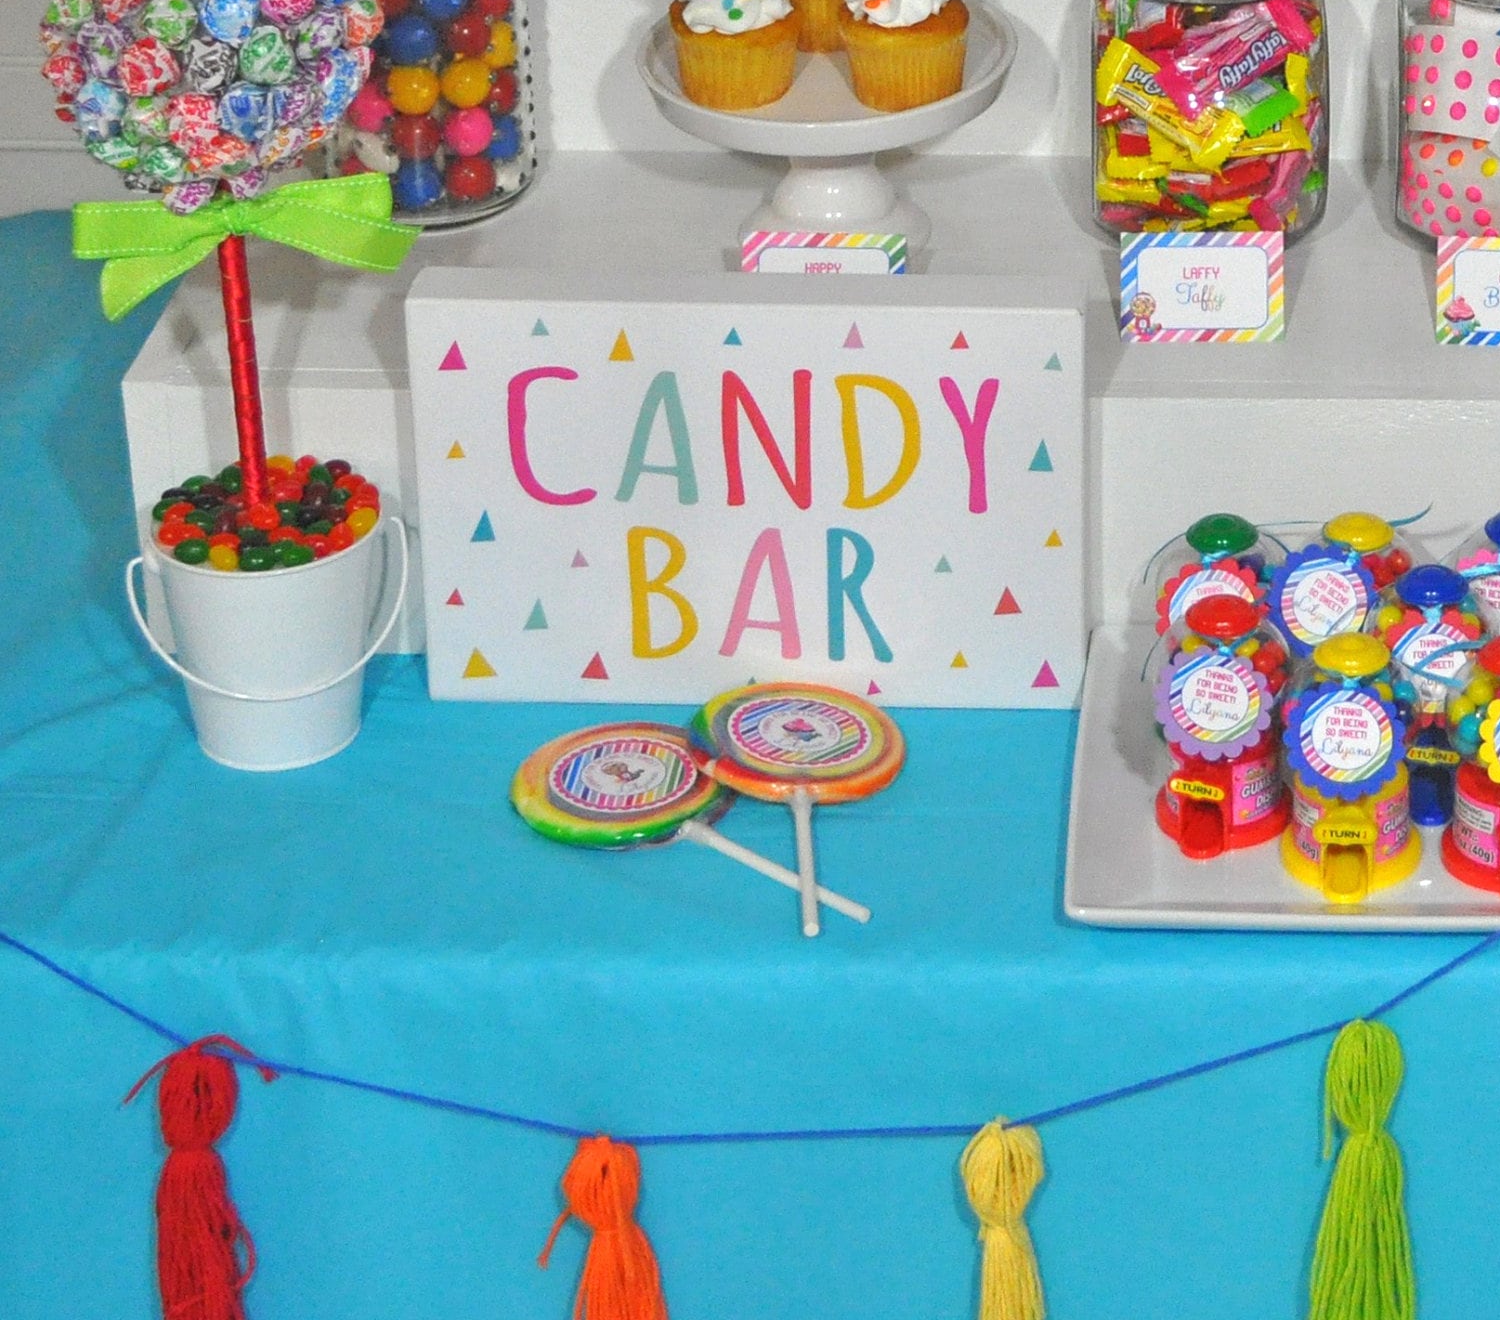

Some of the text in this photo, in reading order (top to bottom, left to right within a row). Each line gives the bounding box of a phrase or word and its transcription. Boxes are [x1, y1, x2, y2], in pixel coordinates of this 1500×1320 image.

[804, 262, 842, 274] HAPPY
[1183, 267, 1220, 280] LAFFY
[1176, 282, 1225, 312] Taffy
[506, 366, 1000, 514] CANDY
[626, 525, 894, 663] BAR
[1417, 750, 1447, 760] TURN
[1182, 783, 1212, 795] TURN
[1329, 829, 1360, 839] TURN
